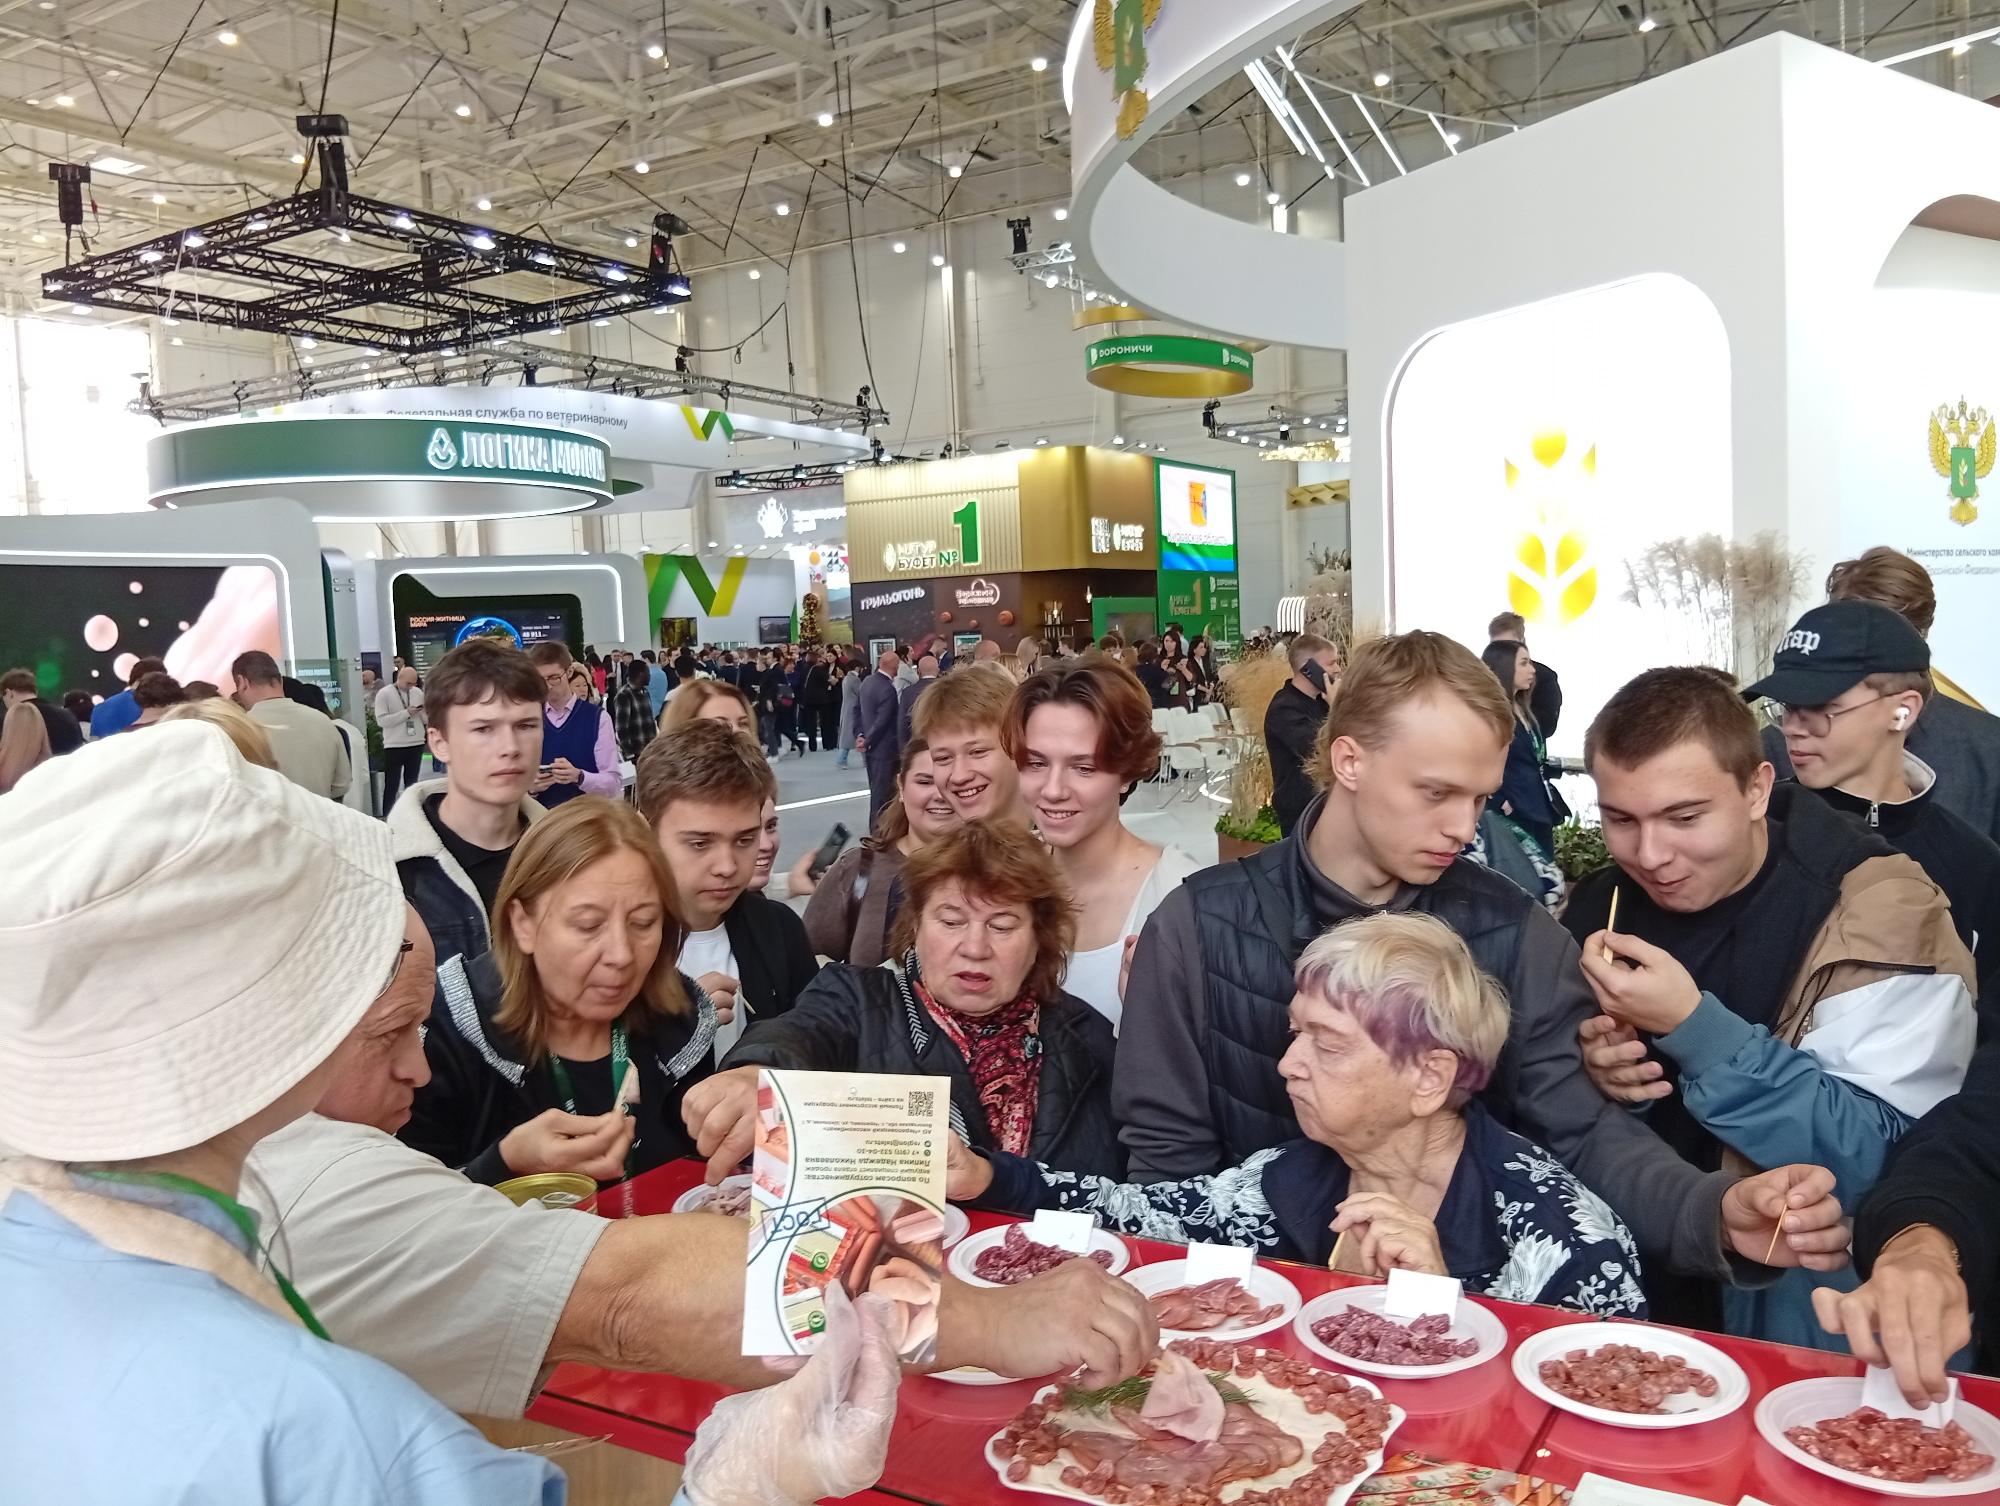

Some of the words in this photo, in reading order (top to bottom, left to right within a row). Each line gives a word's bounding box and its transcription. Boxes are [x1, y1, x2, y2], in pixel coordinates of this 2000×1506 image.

[475, 407, 525, 419] служба
[528, 410, 543, 419] по
[546, 411, 629, 429] ветеринарному
[461, 430, 550, 472] ЛОГИКА
[898, 556, 936, 570] БУФЕТ
